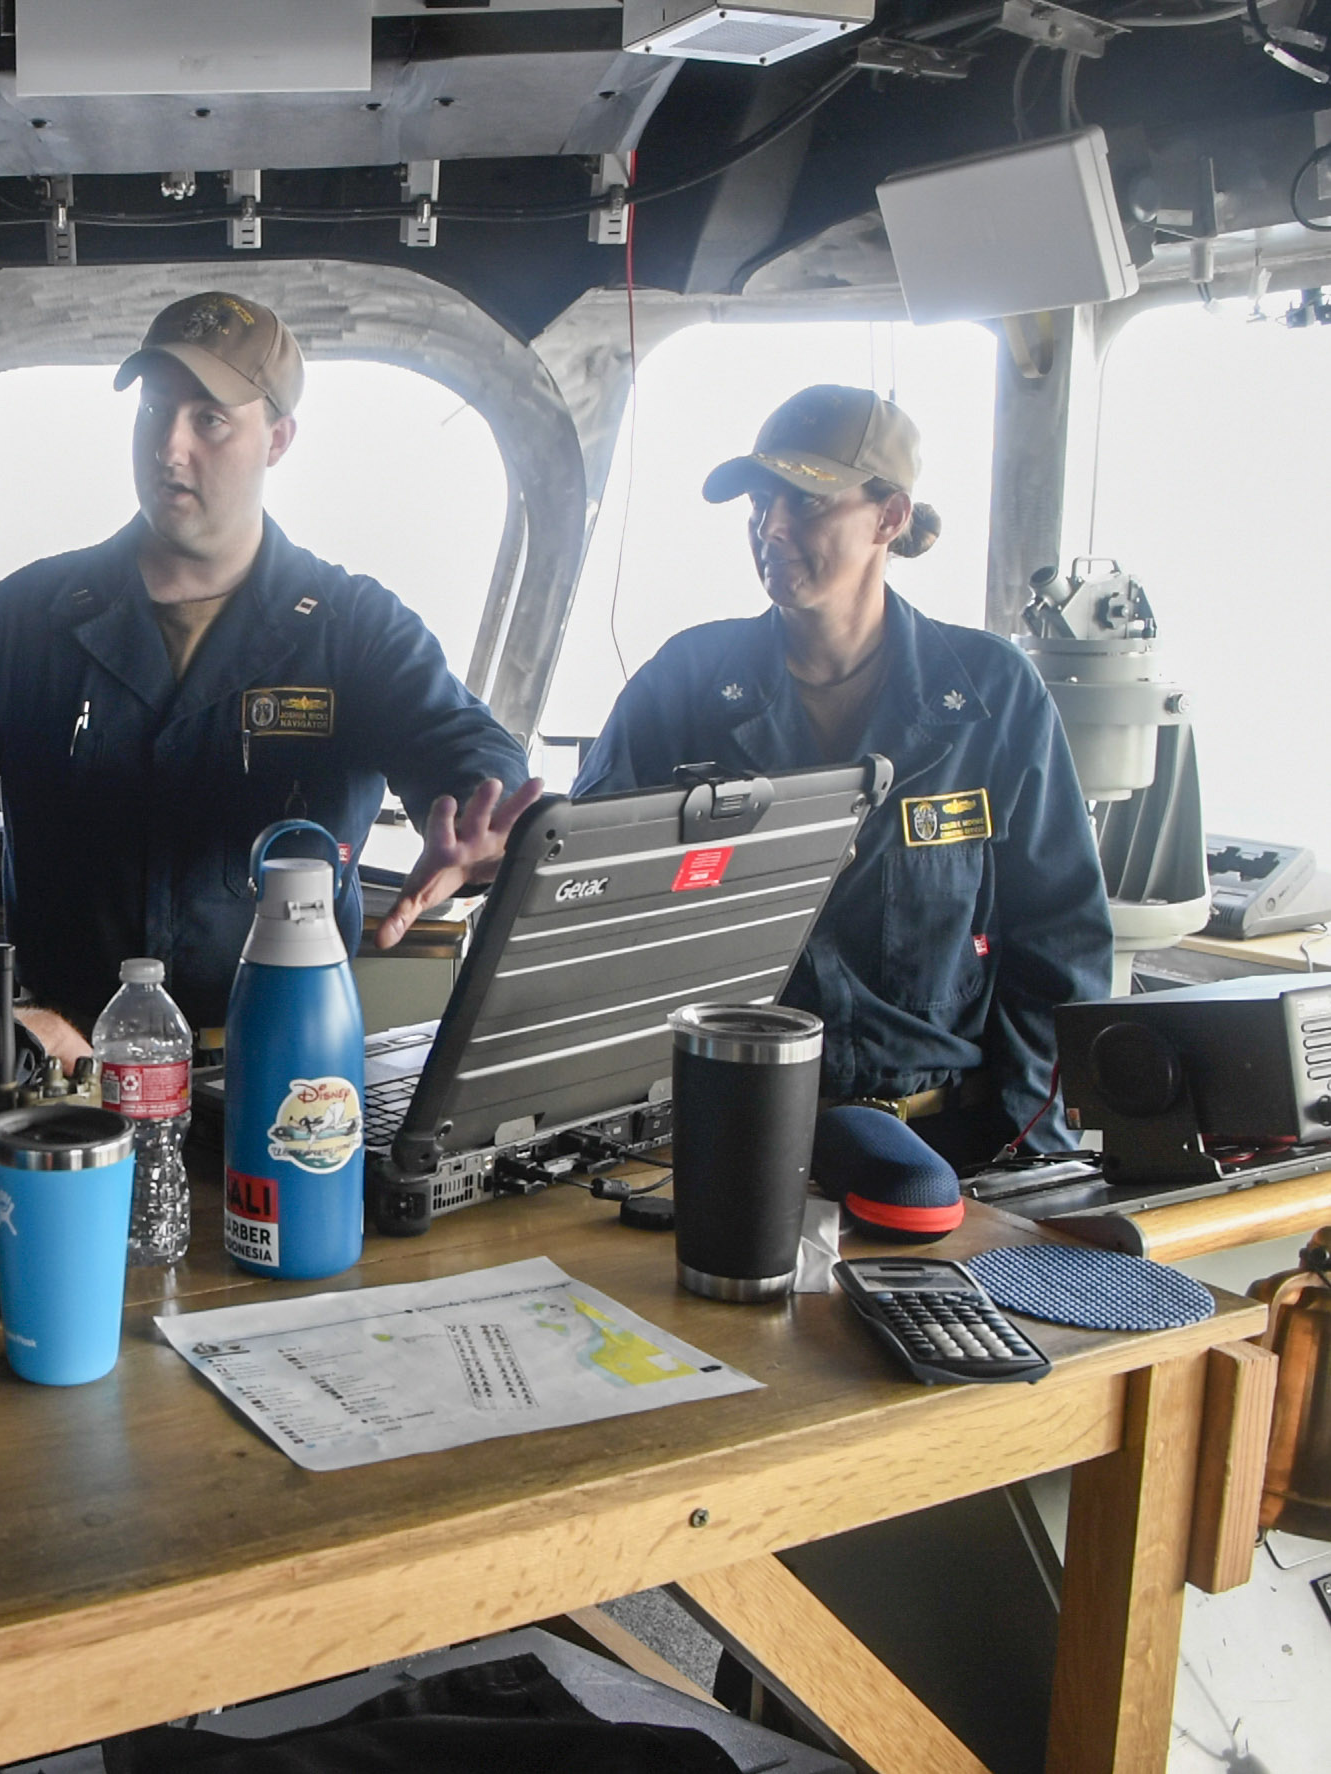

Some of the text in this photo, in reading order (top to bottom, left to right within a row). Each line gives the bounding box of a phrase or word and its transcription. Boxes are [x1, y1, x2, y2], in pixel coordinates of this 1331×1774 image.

[280, 720, 329, 729] NAVIGATOR
[555, 876, 609, 902] Getac
[294, 1083, 351, 1104] Disney
[227, 1179, 271, 1216] ALI
